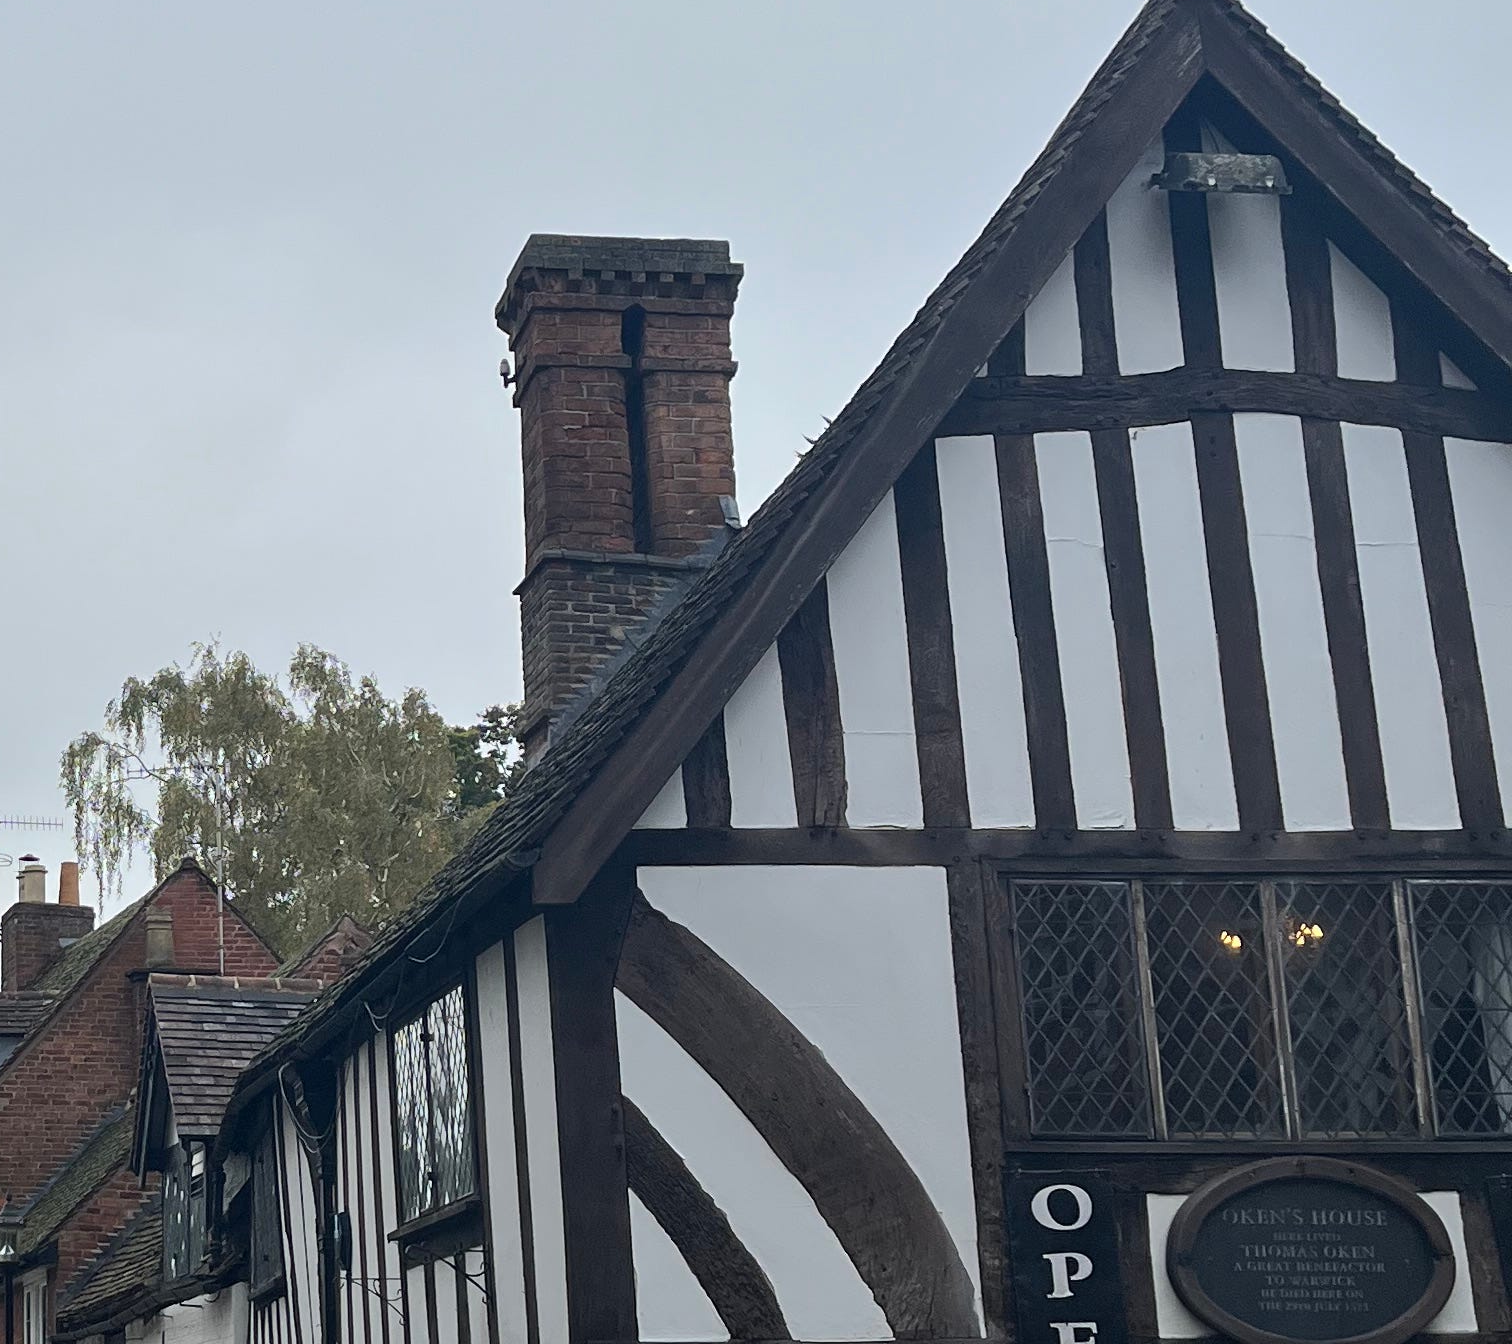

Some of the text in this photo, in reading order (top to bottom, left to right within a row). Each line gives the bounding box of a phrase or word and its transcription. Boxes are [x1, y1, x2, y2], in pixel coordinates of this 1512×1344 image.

[1222, 1207, 1388, 1227] OKEN'S HOUSE
[1240, 1244, 1376, 1259] THOMAS OKEN
[1234, 1261, 1386, 1273] A GREAT BENEFACTOR
[1265, 1275, 1356, 1287] TO WARWICK
